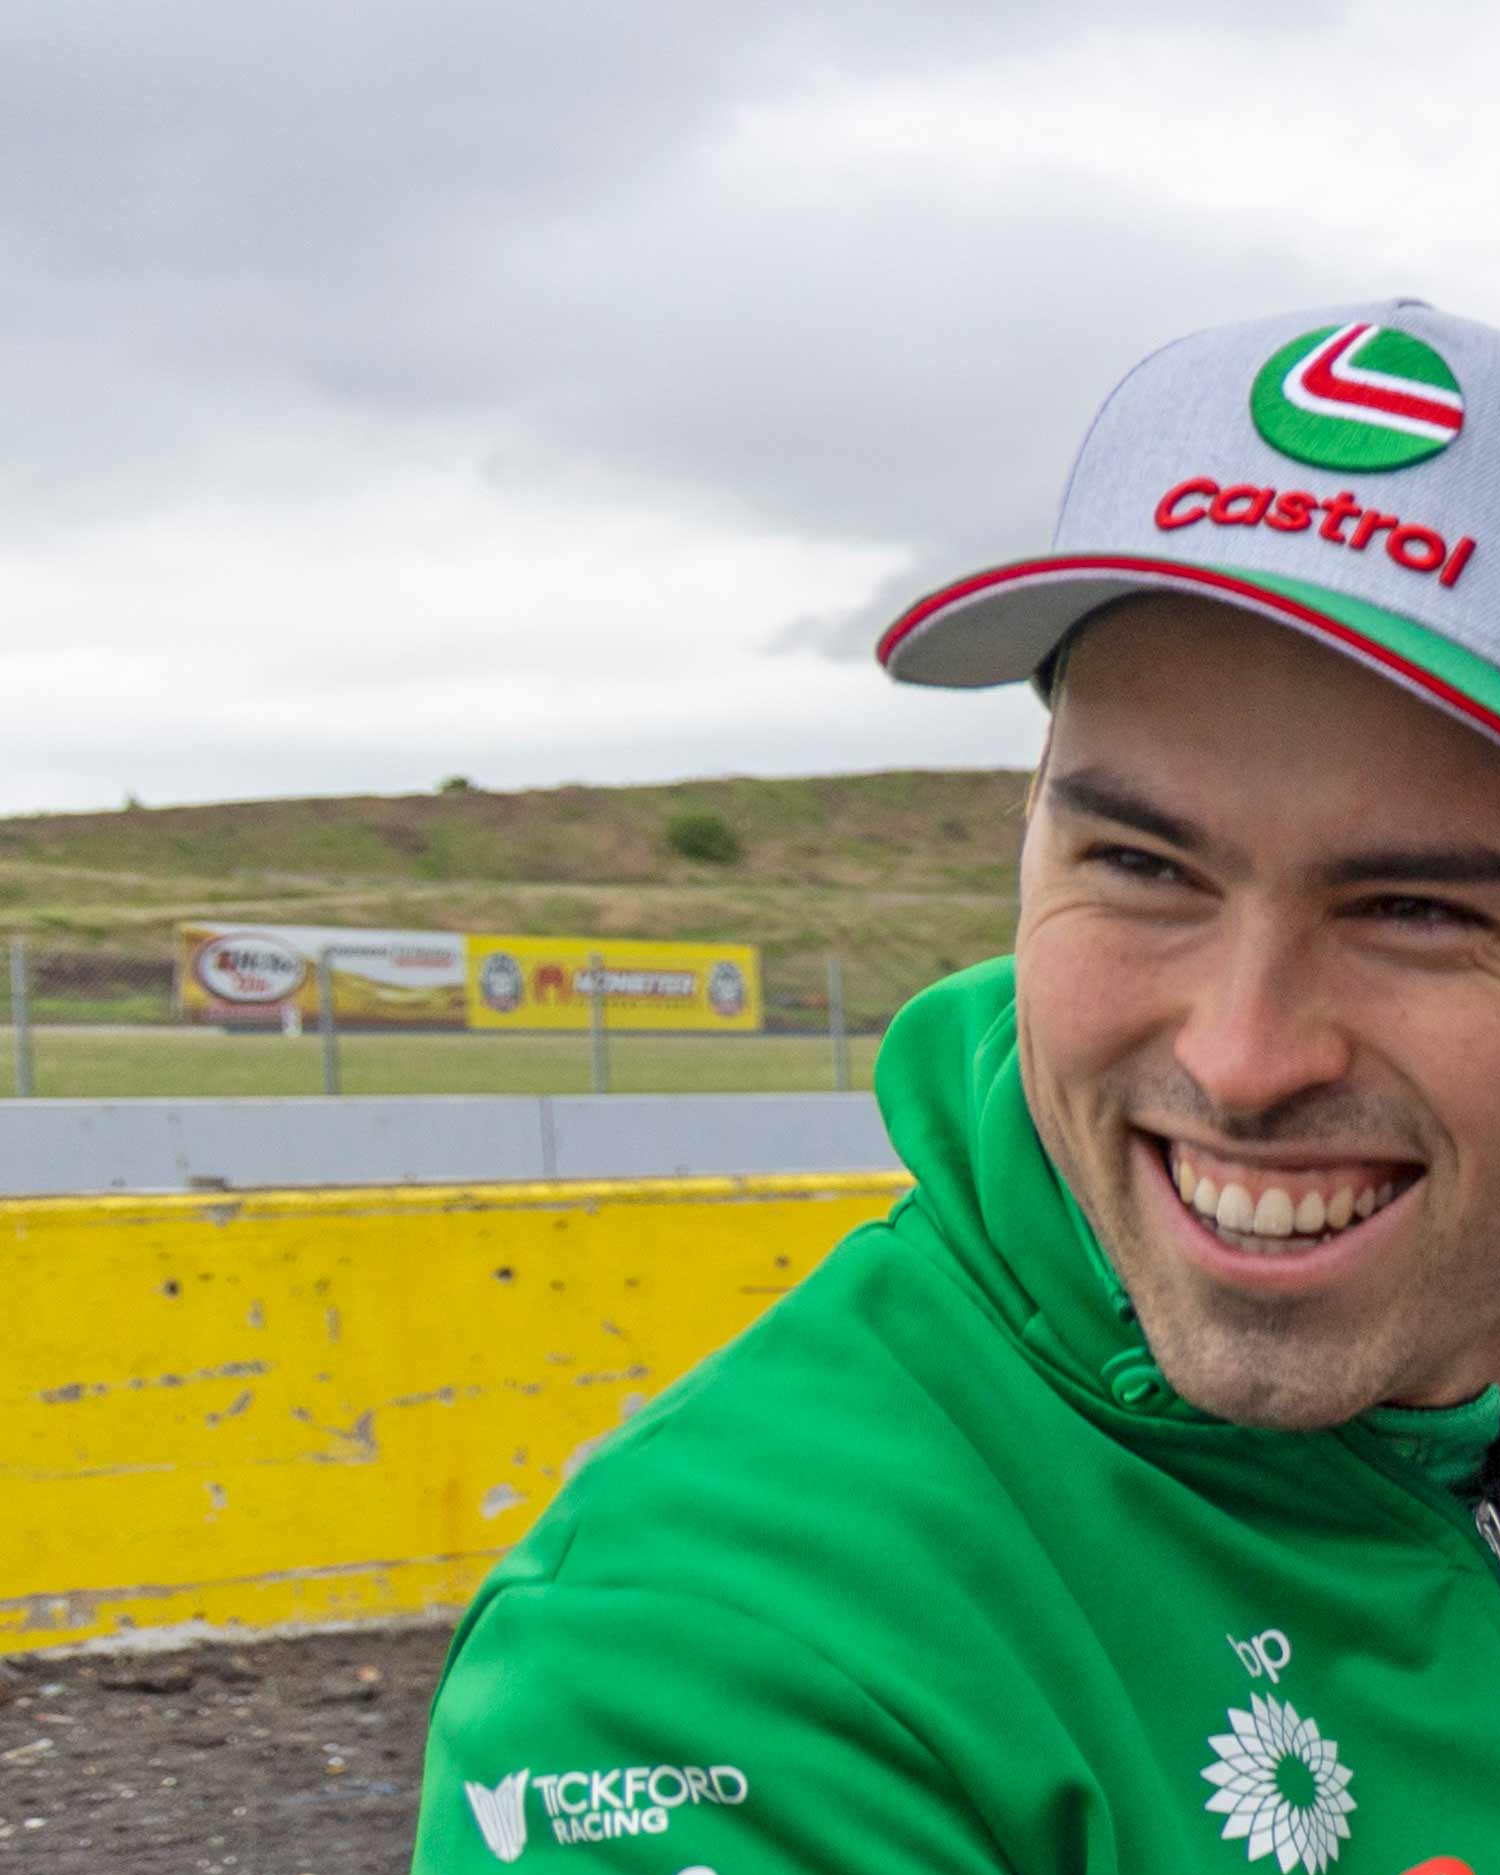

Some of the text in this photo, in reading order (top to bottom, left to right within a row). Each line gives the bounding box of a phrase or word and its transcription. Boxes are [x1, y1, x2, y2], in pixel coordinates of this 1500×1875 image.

[1154, 476, 1477, 588] Castrol
[1226, 1628, 1292, 1683] bp
[533, 1765, 748, 1814] TICKFORD
[553, 1806, 669, 1846] RACING
